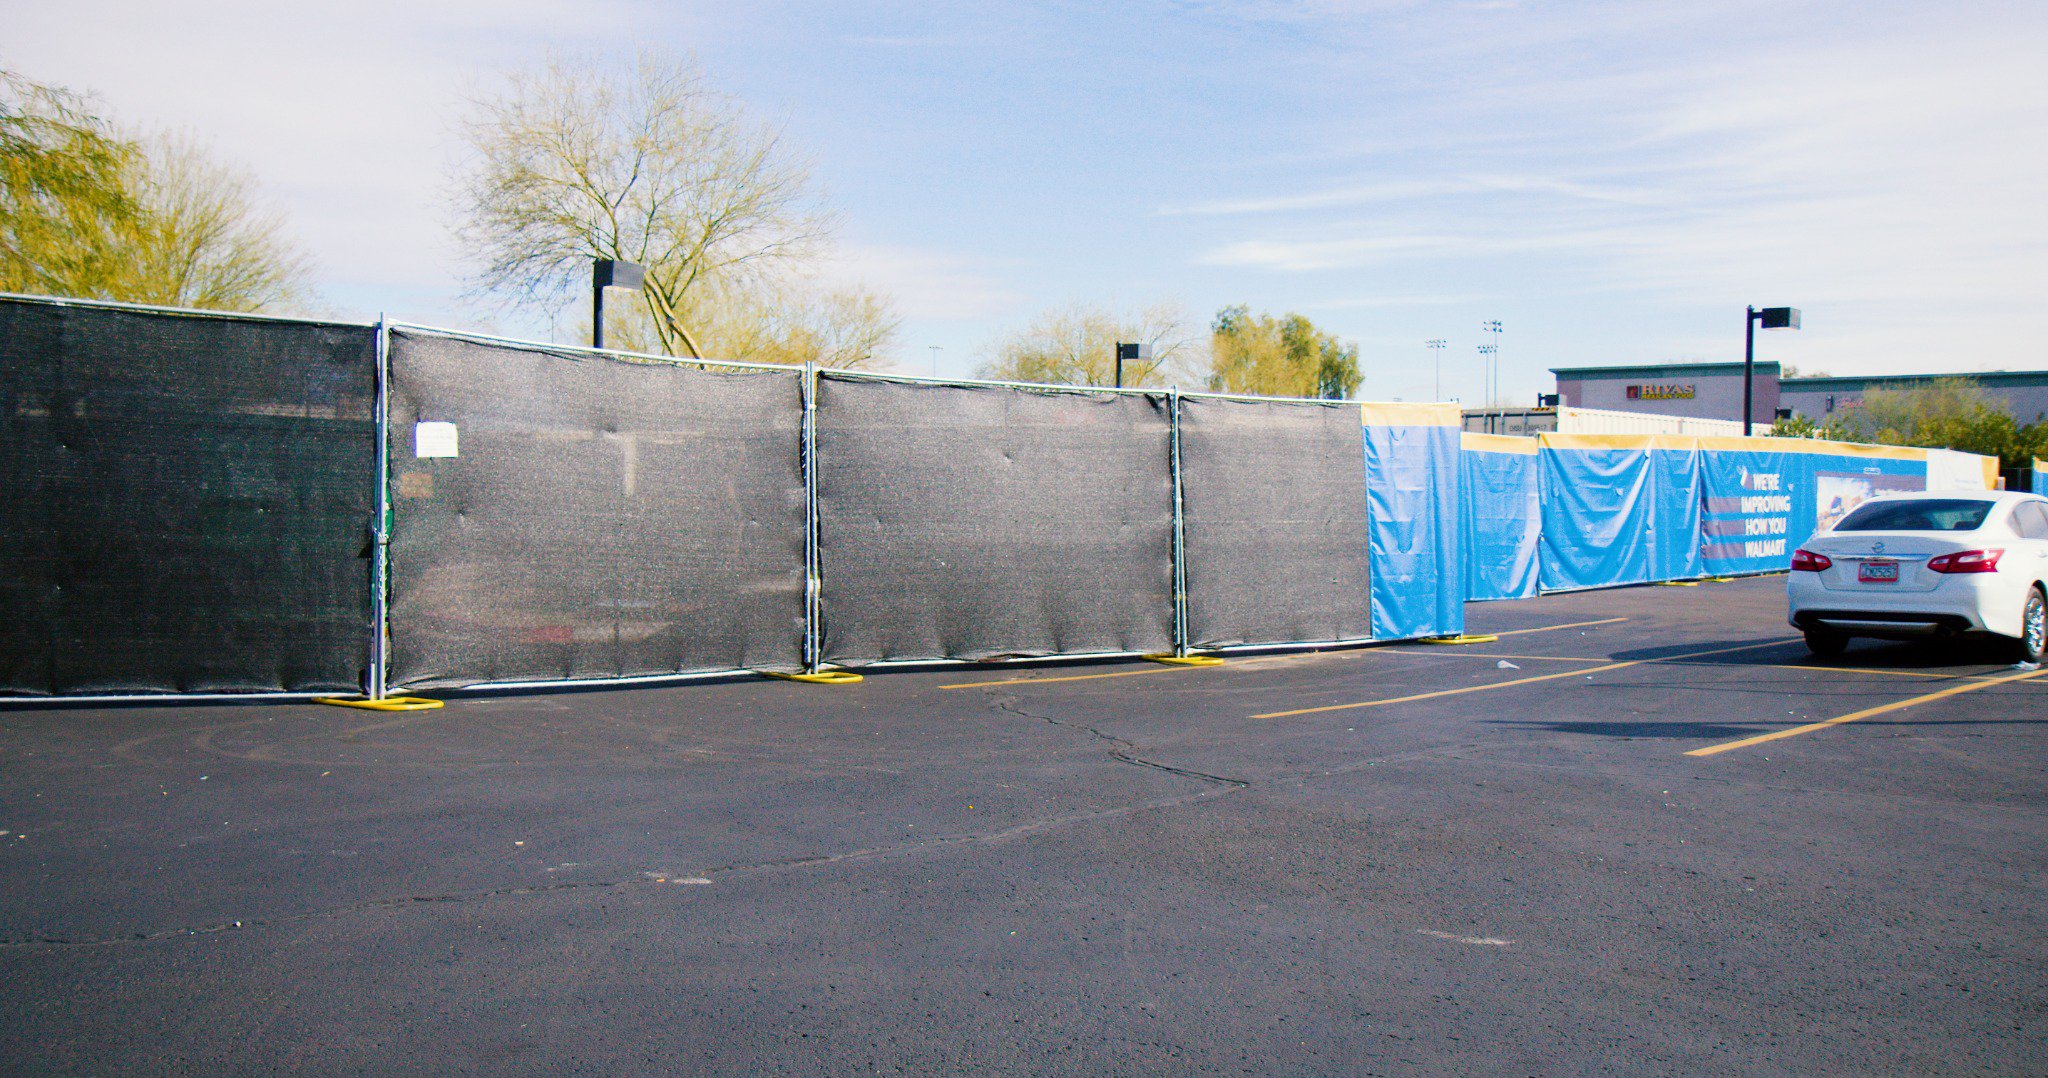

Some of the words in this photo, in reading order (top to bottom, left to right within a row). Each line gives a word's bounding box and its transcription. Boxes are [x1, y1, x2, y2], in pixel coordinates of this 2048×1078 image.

[1641, 384, 1695, 394] RIVAS
[1753, 473, 1780, 490] WE'RE
[1741, 495, 1791, 513] IMPROVING
[1745, 518, 1769, 535] HOW
[1768, 517, 1786, 534] YOU
[1745, 538, 1786, 558] WALMART
